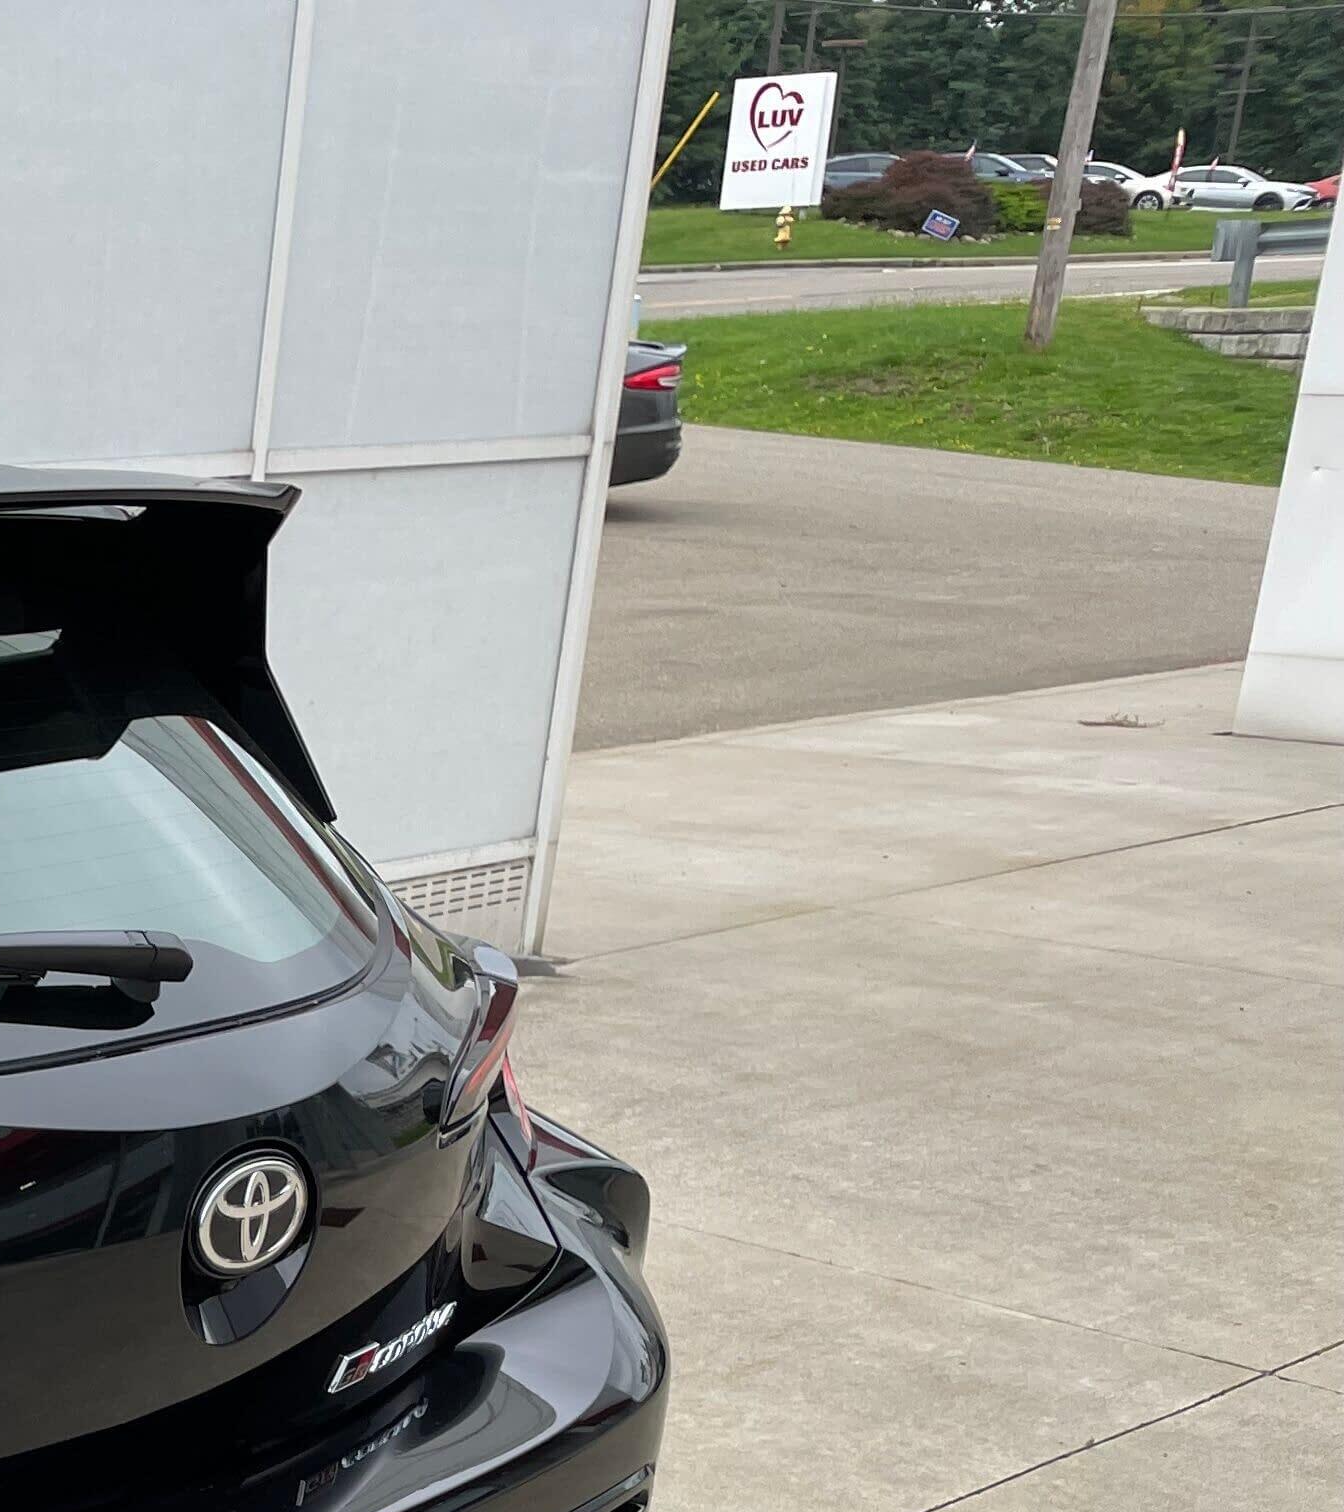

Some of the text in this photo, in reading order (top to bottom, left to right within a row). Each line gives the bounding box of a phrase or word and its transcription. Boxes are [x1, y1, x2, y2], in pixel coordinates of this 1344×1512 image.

[757, 108, 804, 129] LUV
[731, 156, 810, 173] USED CARS
